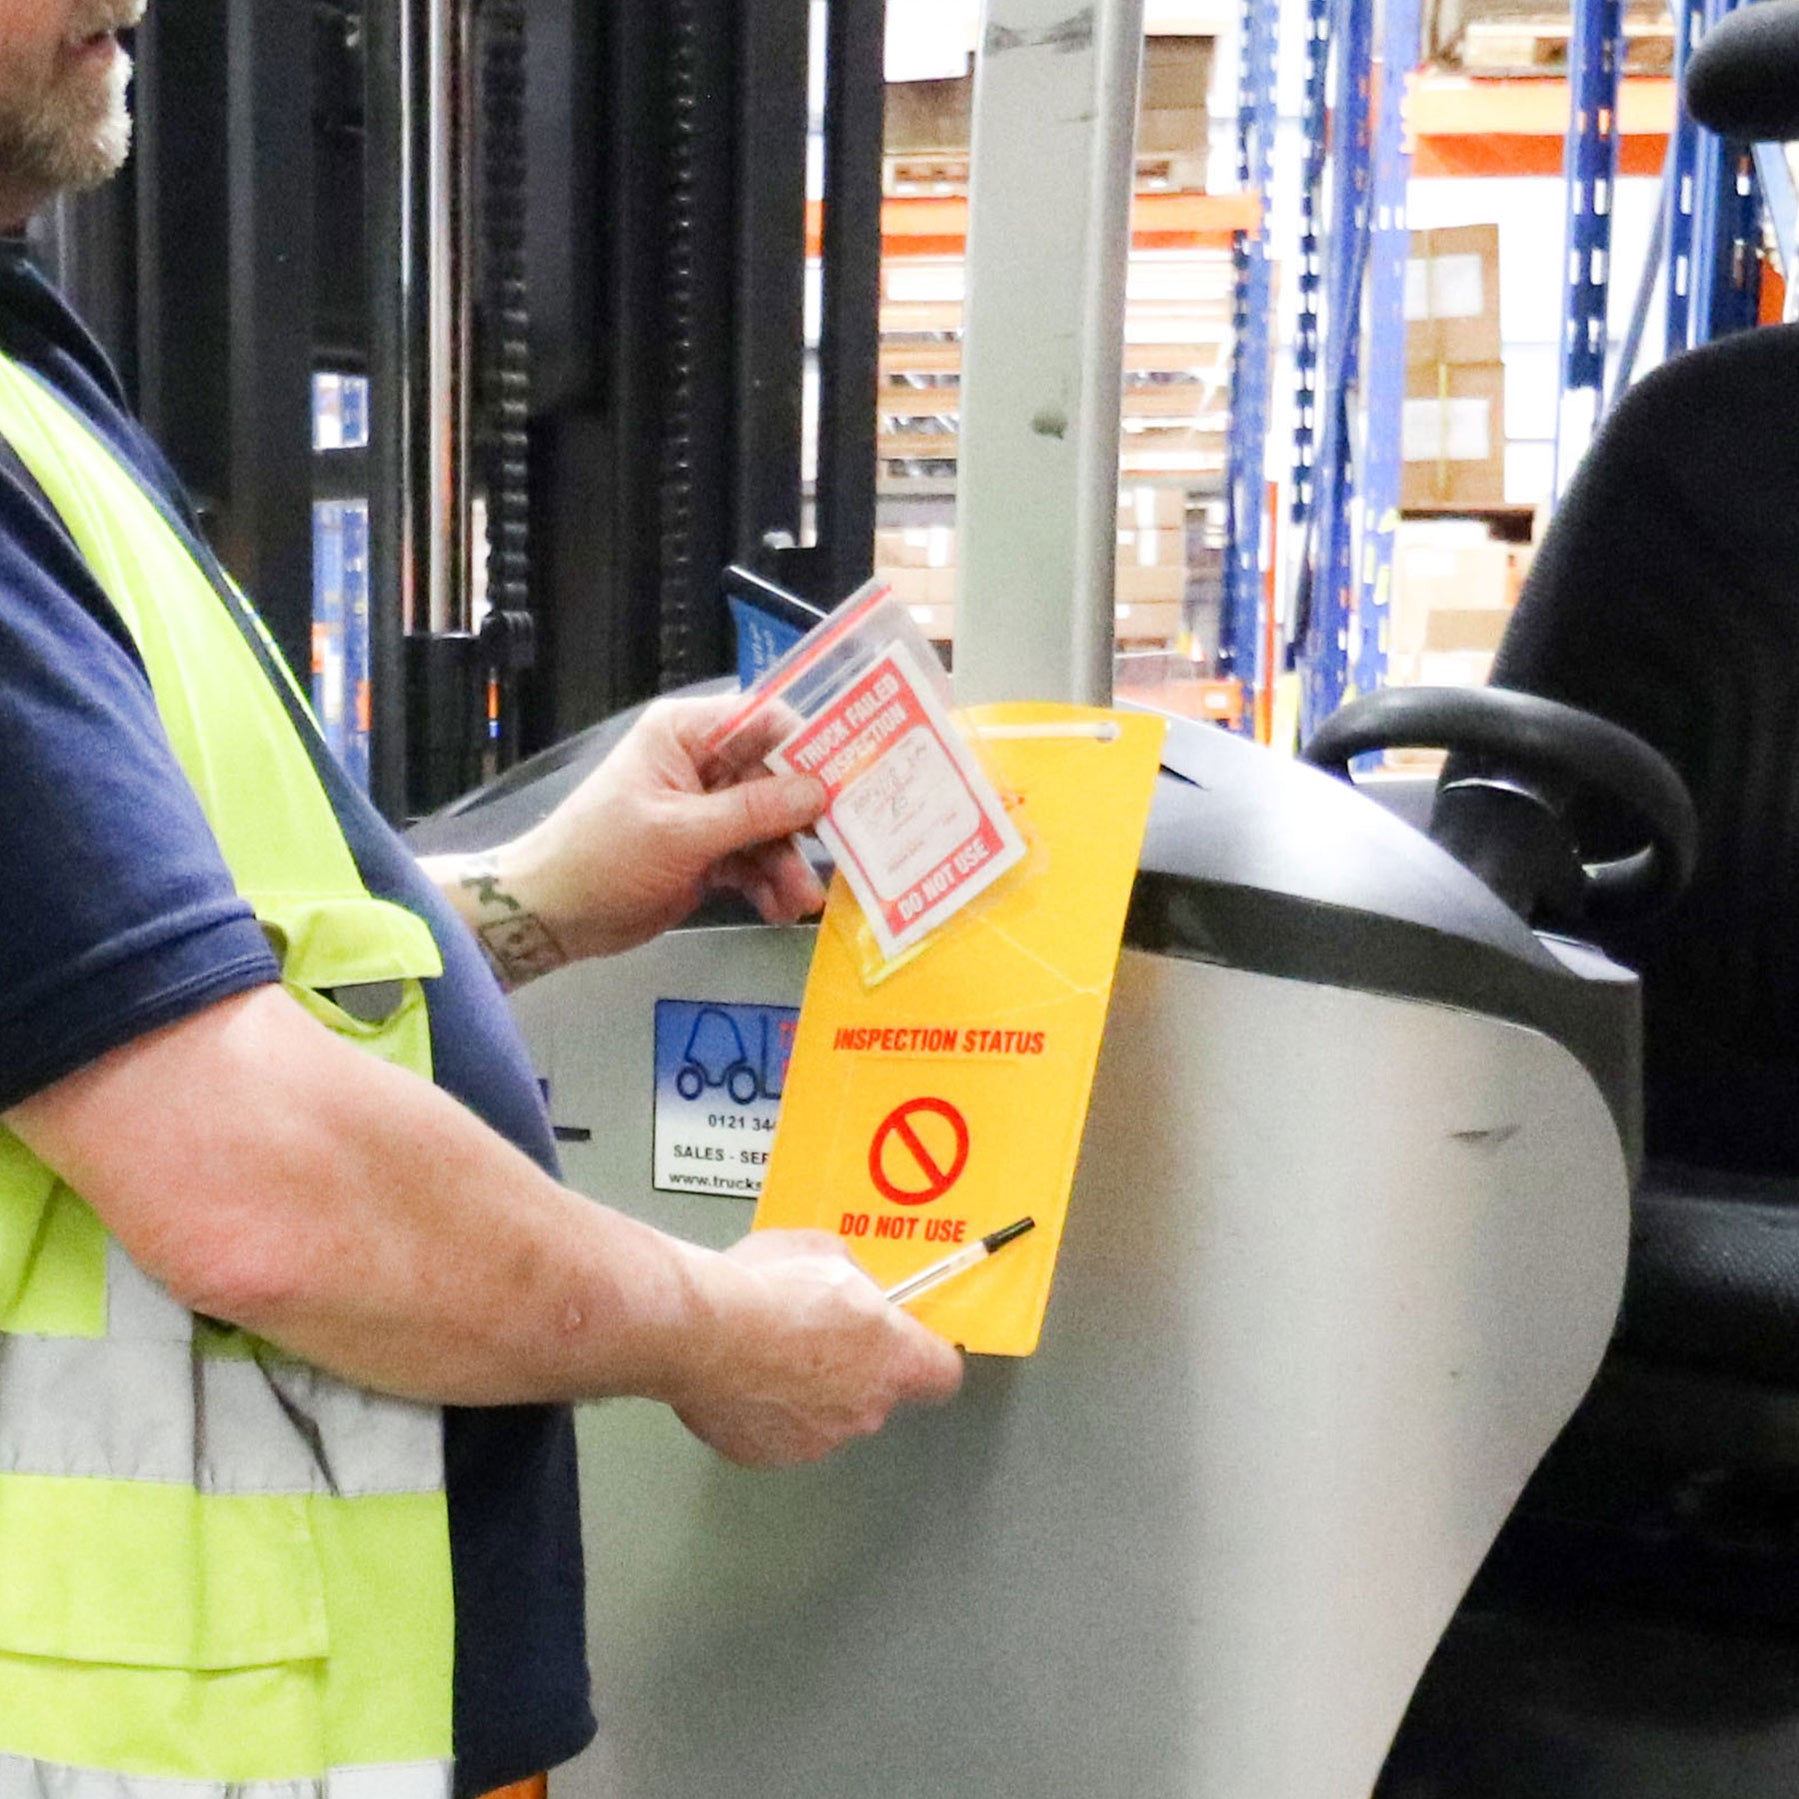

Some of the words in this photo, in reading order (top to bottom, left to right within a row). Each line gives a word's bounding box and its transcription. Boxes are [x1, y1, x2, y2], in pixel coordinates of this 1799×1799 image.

[794, 718, 850, 771] TRUCK
[844, 673, 899, 730] FAILED
[819, 701, 909, 788] INSPECTION
[897, 890, 924, 922] DO
[921, 862, 956, 902] NOT
[953, 837, 990, 875] USE
[833, 1027, 958, 1052] INSPECTION
[962, 1029, 1046, 1055] STATUS
[708, 1114, 745, 1129] 0121
[673, 1144, 725, 1162] SALES
[839, 1212, 870, 1237] DO
[874, 1215, 919, 1240] NOT
[923, 1218, 967, 1243] USE
